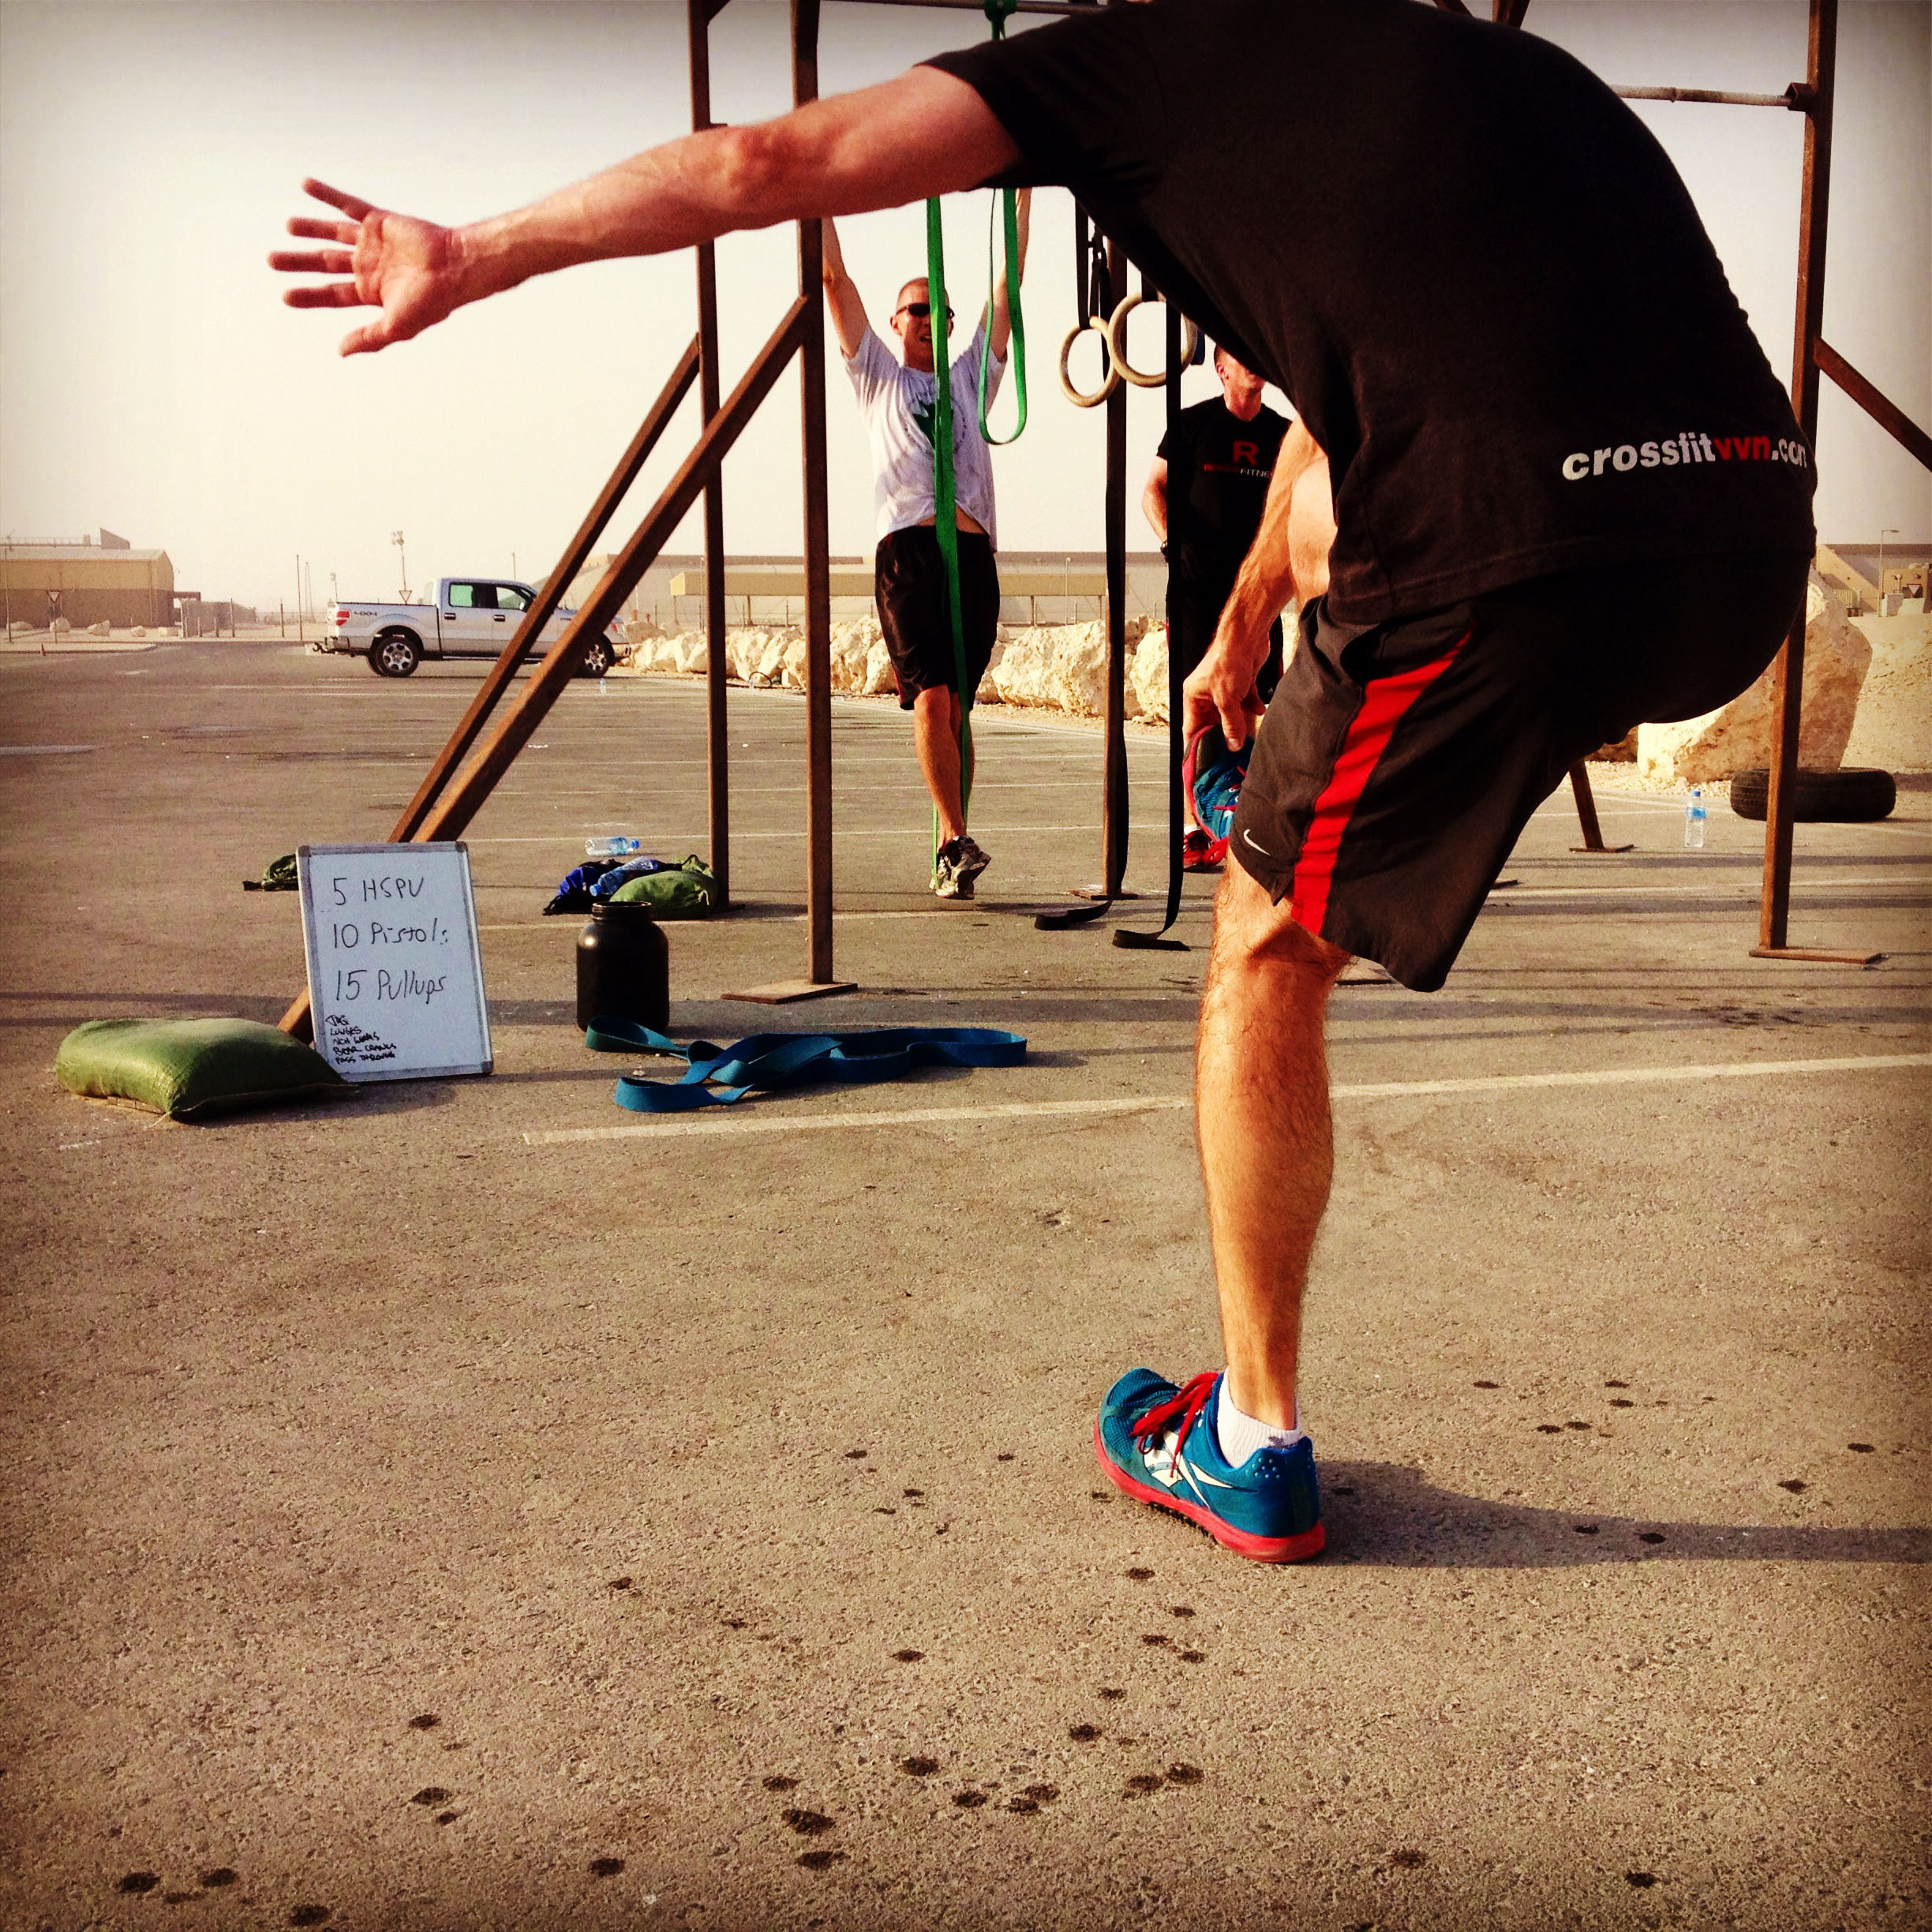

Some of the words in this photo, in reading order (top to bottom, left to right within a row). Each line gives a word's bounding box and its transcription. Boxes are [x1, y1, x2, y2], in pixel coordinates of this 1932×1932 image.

[1240, 468, 1273, 478] FITNE
[333, 878, 346, 905] 5
[334, 923, 358, 948] 10
[335, 970, 367, 1001] 15
[377, 970, 447, 1004] Pullups
